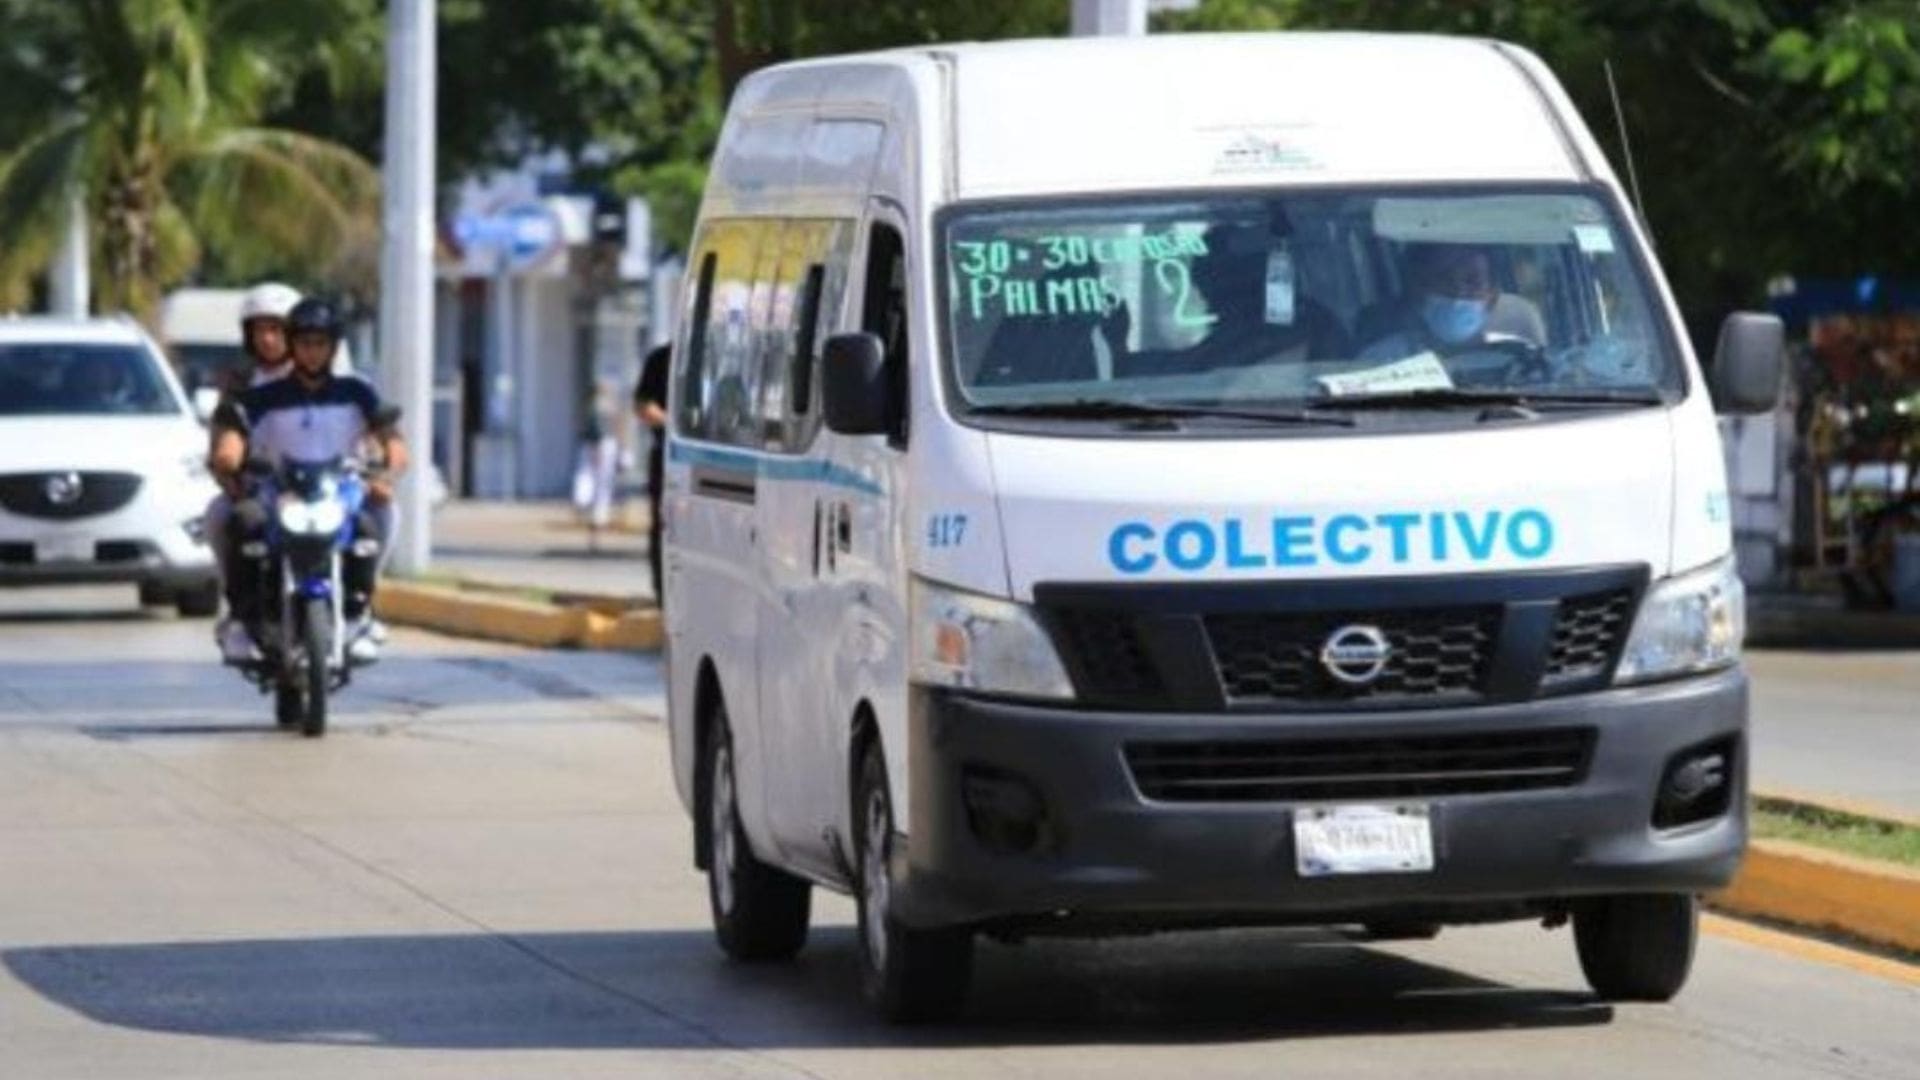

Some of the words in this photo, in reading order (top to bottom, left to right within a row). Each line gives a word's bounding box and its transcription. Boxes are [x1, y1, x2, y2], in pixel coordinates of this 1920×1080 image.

[970, 273, 1121, 320] PALMAS
[1155, 257, 1219, 325] 2
[1107, 509, 1555, 574] COLECTIVO
